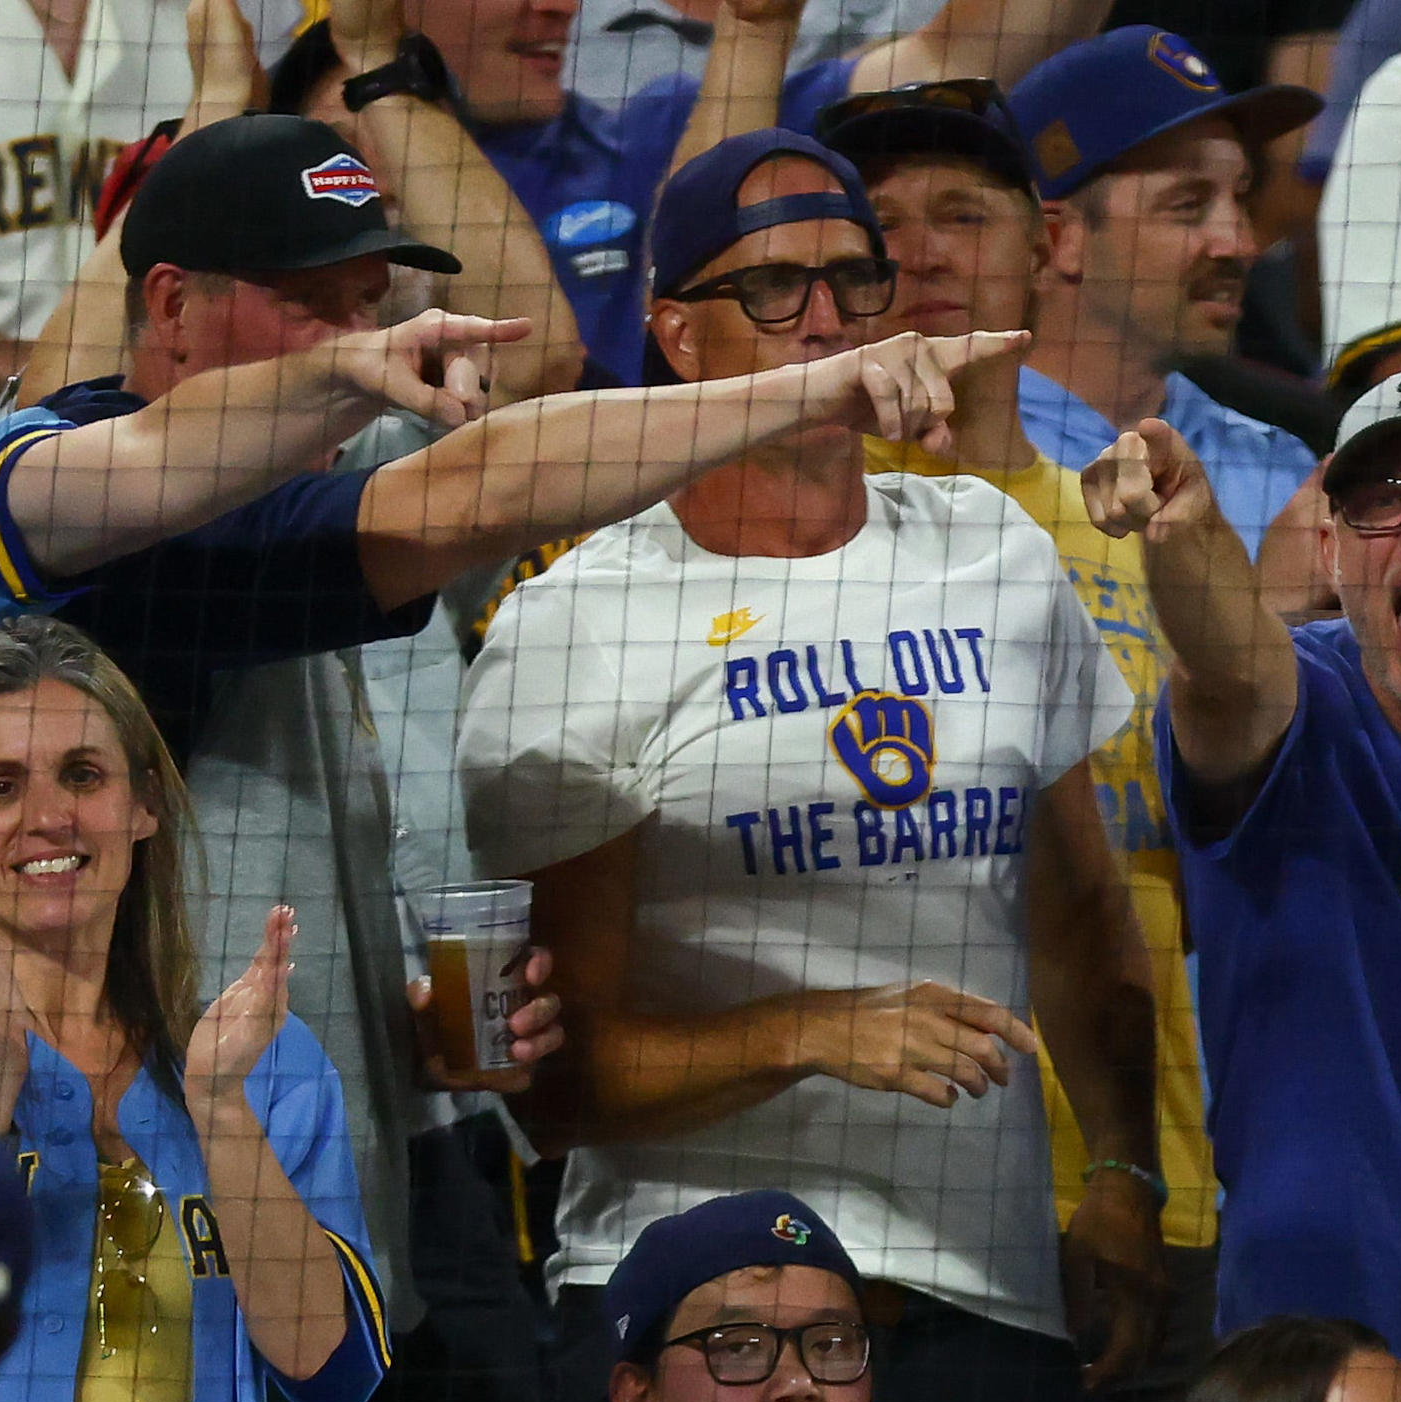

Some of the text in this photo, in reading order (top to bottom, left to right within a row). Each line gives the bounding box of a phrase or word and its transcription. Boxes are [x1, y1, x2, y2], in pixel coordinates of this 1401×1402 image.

[725, 627, 991, 721] ROLL OUT
[725, 802, 842, 876] THE
